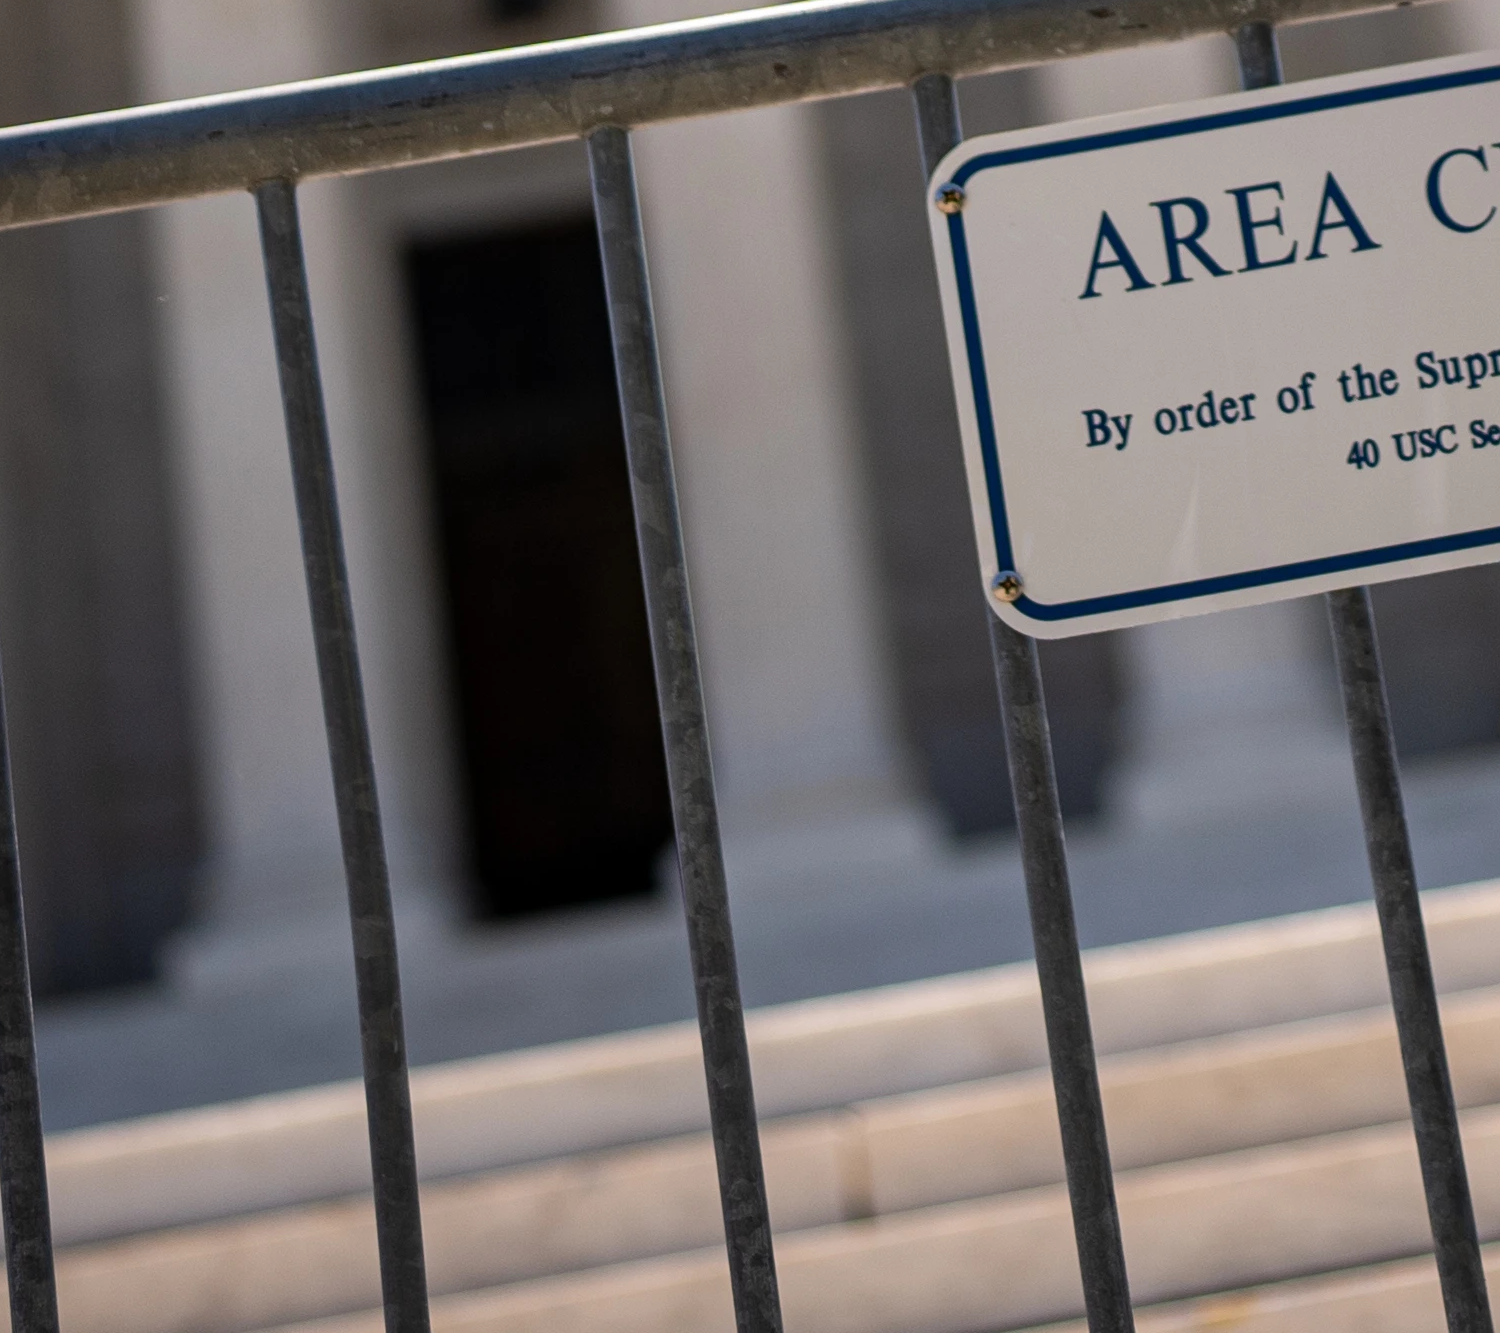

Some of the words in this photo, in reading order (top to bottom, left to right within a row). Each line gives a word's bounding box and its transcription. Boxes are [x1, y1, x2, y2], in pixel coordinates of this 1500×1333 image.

[1077, 170, 1384, 301] AREA
[1080, 407, 1134, 453] By
[1153, 389, 1257, 437] order
[1275, 370, 1318, 416] of
[1336, 362, 1401, 405] the
[1345, 437, 1382, 471] 40
[1390, 423, 1460, 463] USC
